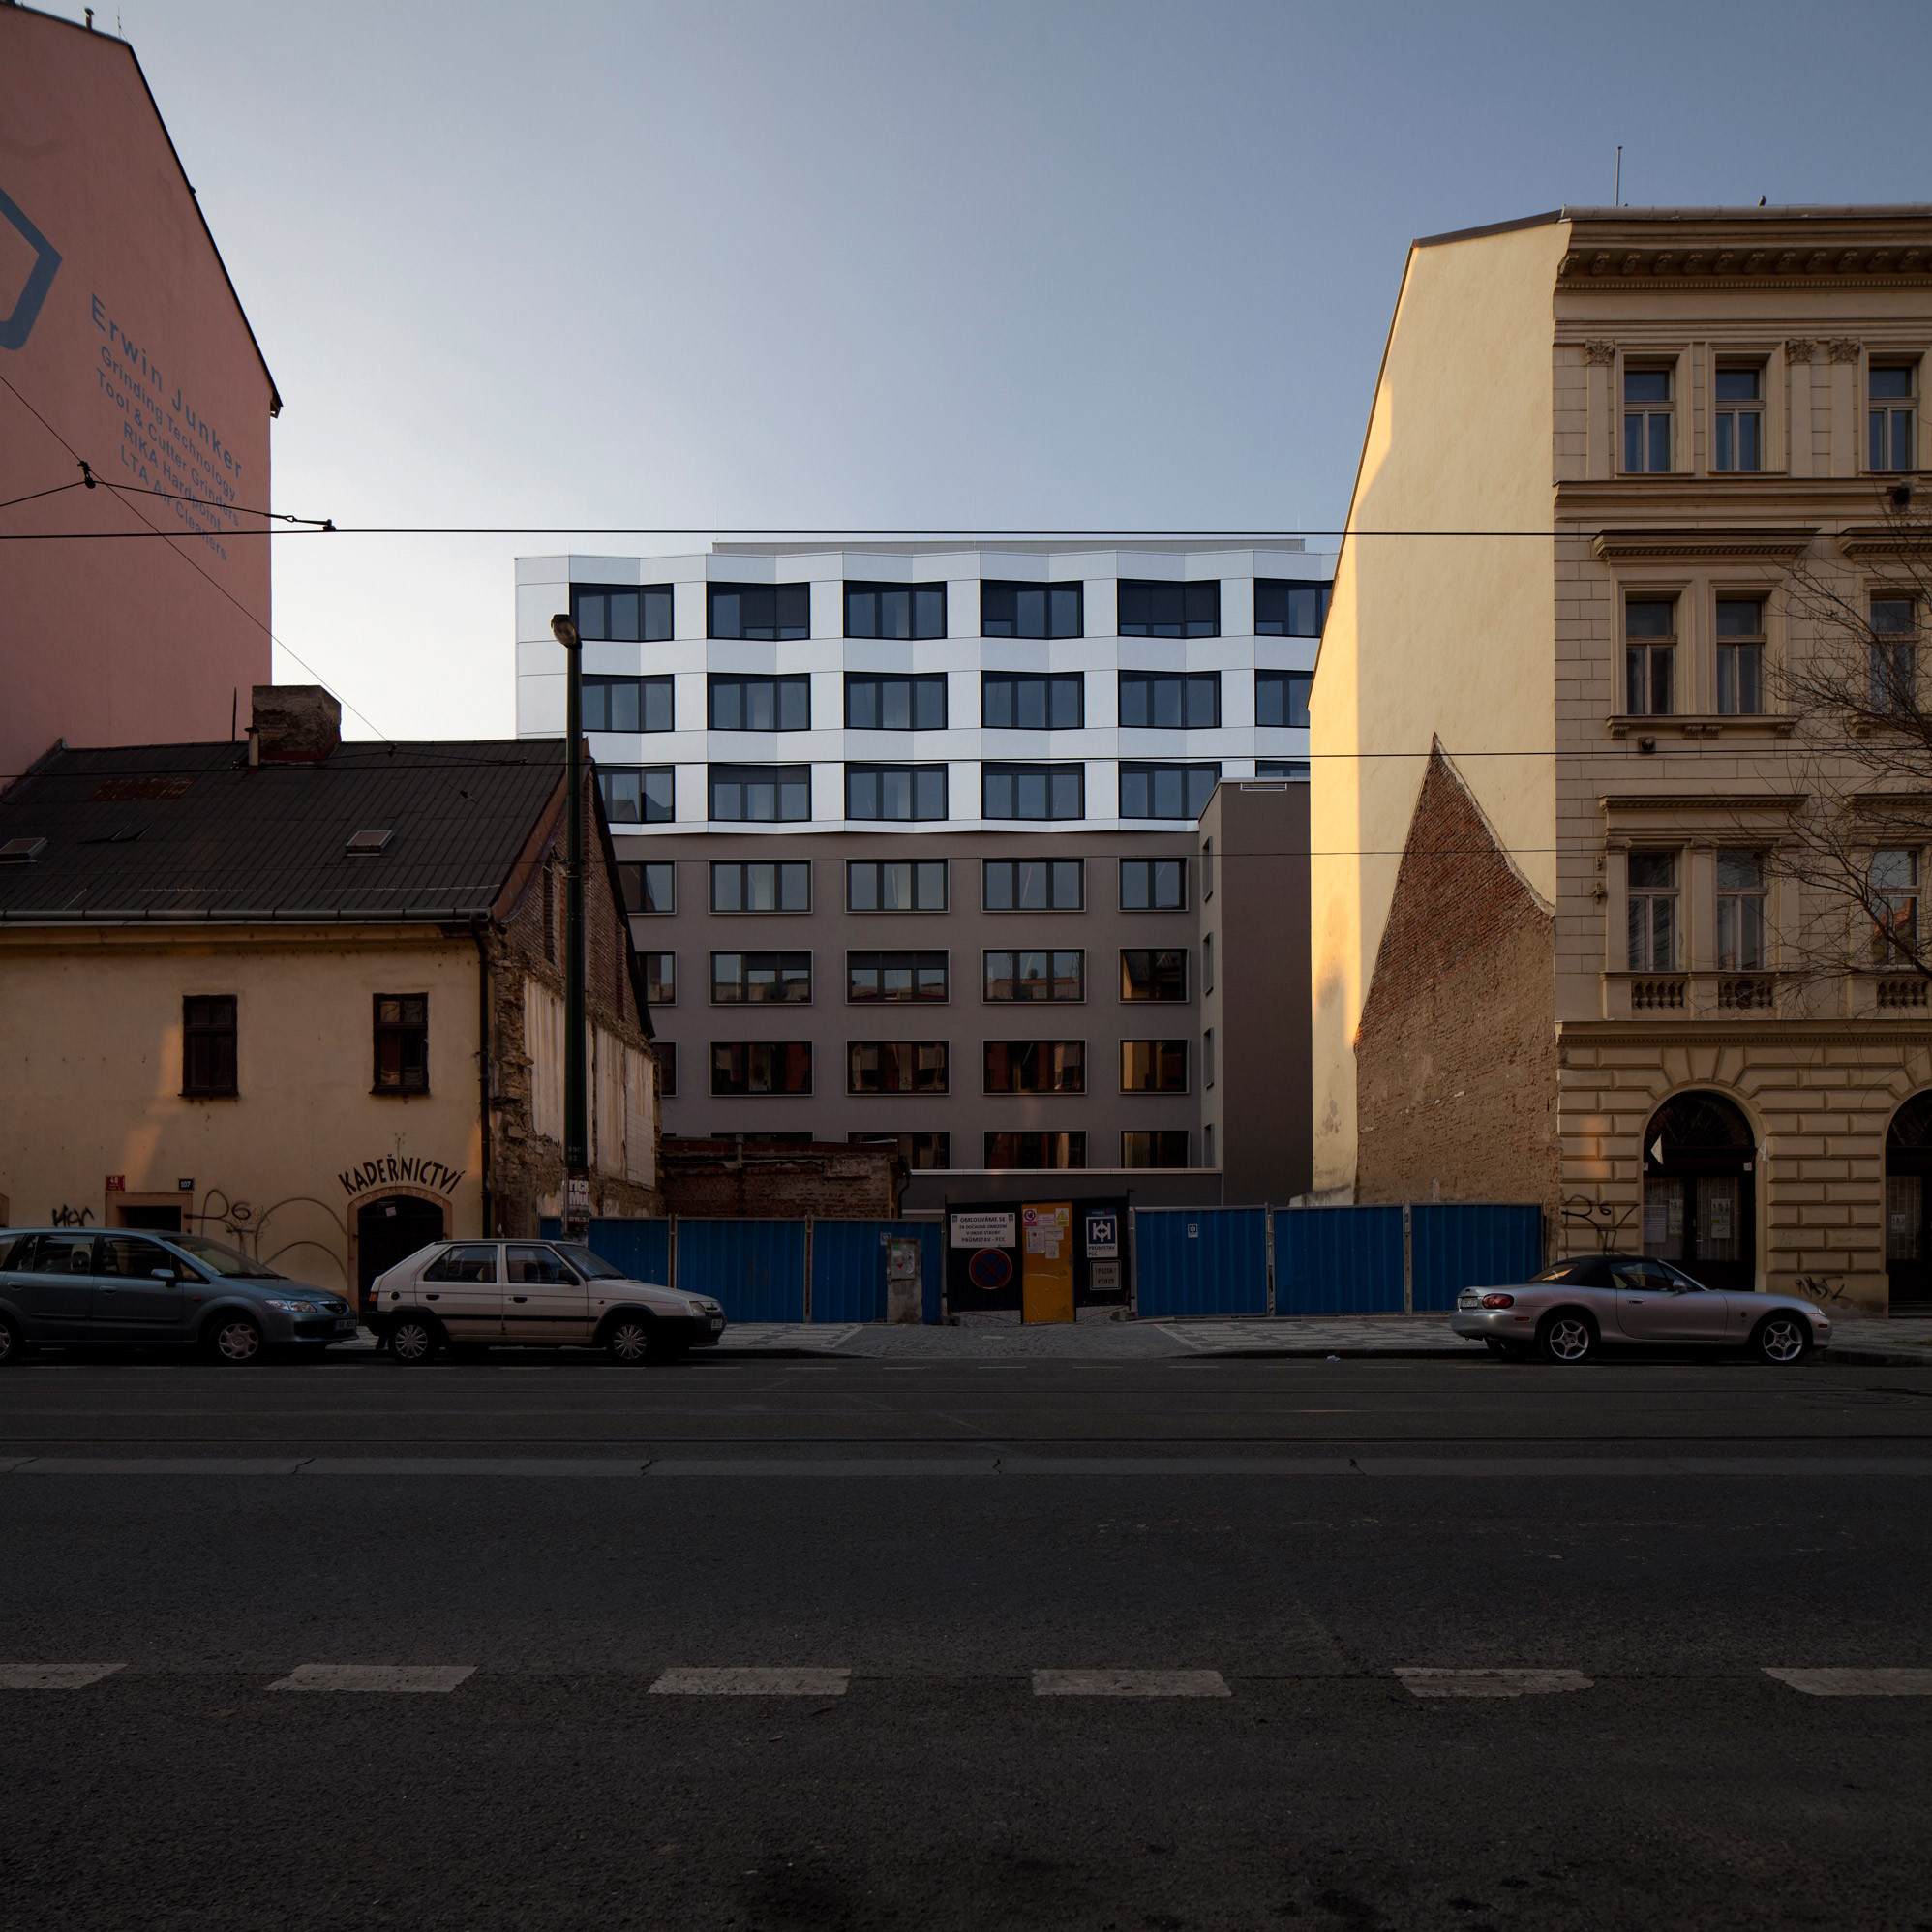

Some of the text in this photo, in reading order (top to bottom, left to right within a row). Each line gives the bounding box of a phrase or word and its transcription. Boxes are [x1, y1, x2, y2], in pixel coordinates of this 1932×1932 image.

[91, 292, 242, 479] Erwin Junker
[101, 345, 236, 504] Grinding Technology
[95, 368, 240, 527] Tool & Cutter Grinders
[121, 445, 226, 561] LTA Air Cleaners
[124, 420, 221, 532] RIKA Hardpoint
[337, 1153, 467, 1196] KADEŘNICTVÍ
[354, 1187, 444, 1209] KOSMETIKA
